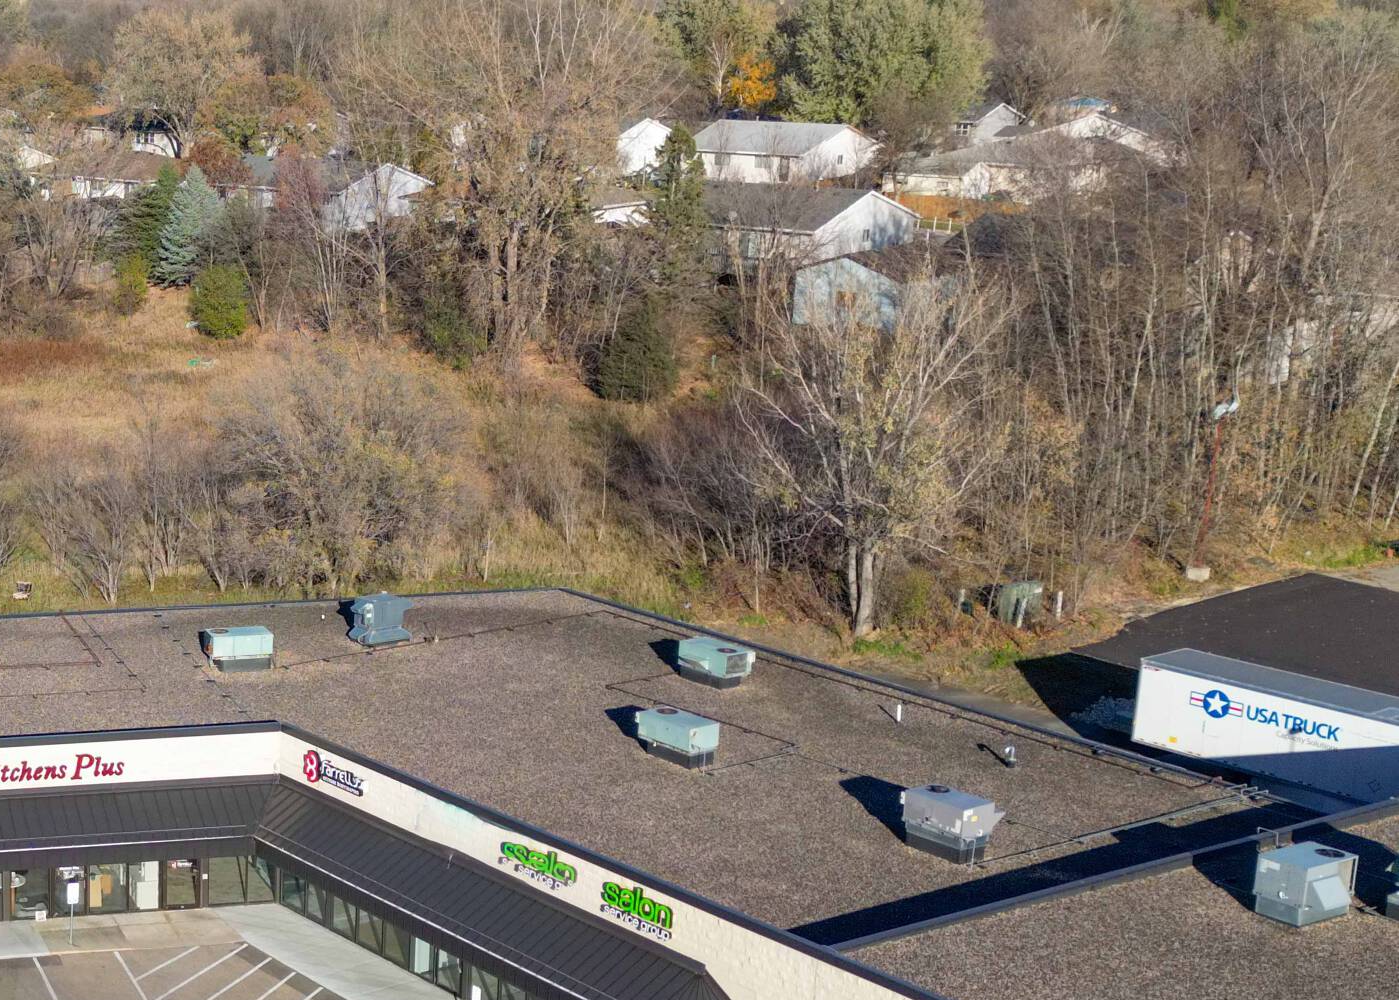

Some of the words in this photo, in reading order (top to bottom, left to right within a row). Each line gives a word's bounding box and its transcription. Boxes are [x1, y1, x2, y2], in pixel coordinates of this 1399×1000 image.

[1246, 705, 1279, 727] USA
[1282, 714, 1340, 742] TRUCK
[71, 754, 125, 780] Plus
[602, 881, 673, 929] salon
[603, 904, 640, 929] service
[640, 919, 671, 940] group
